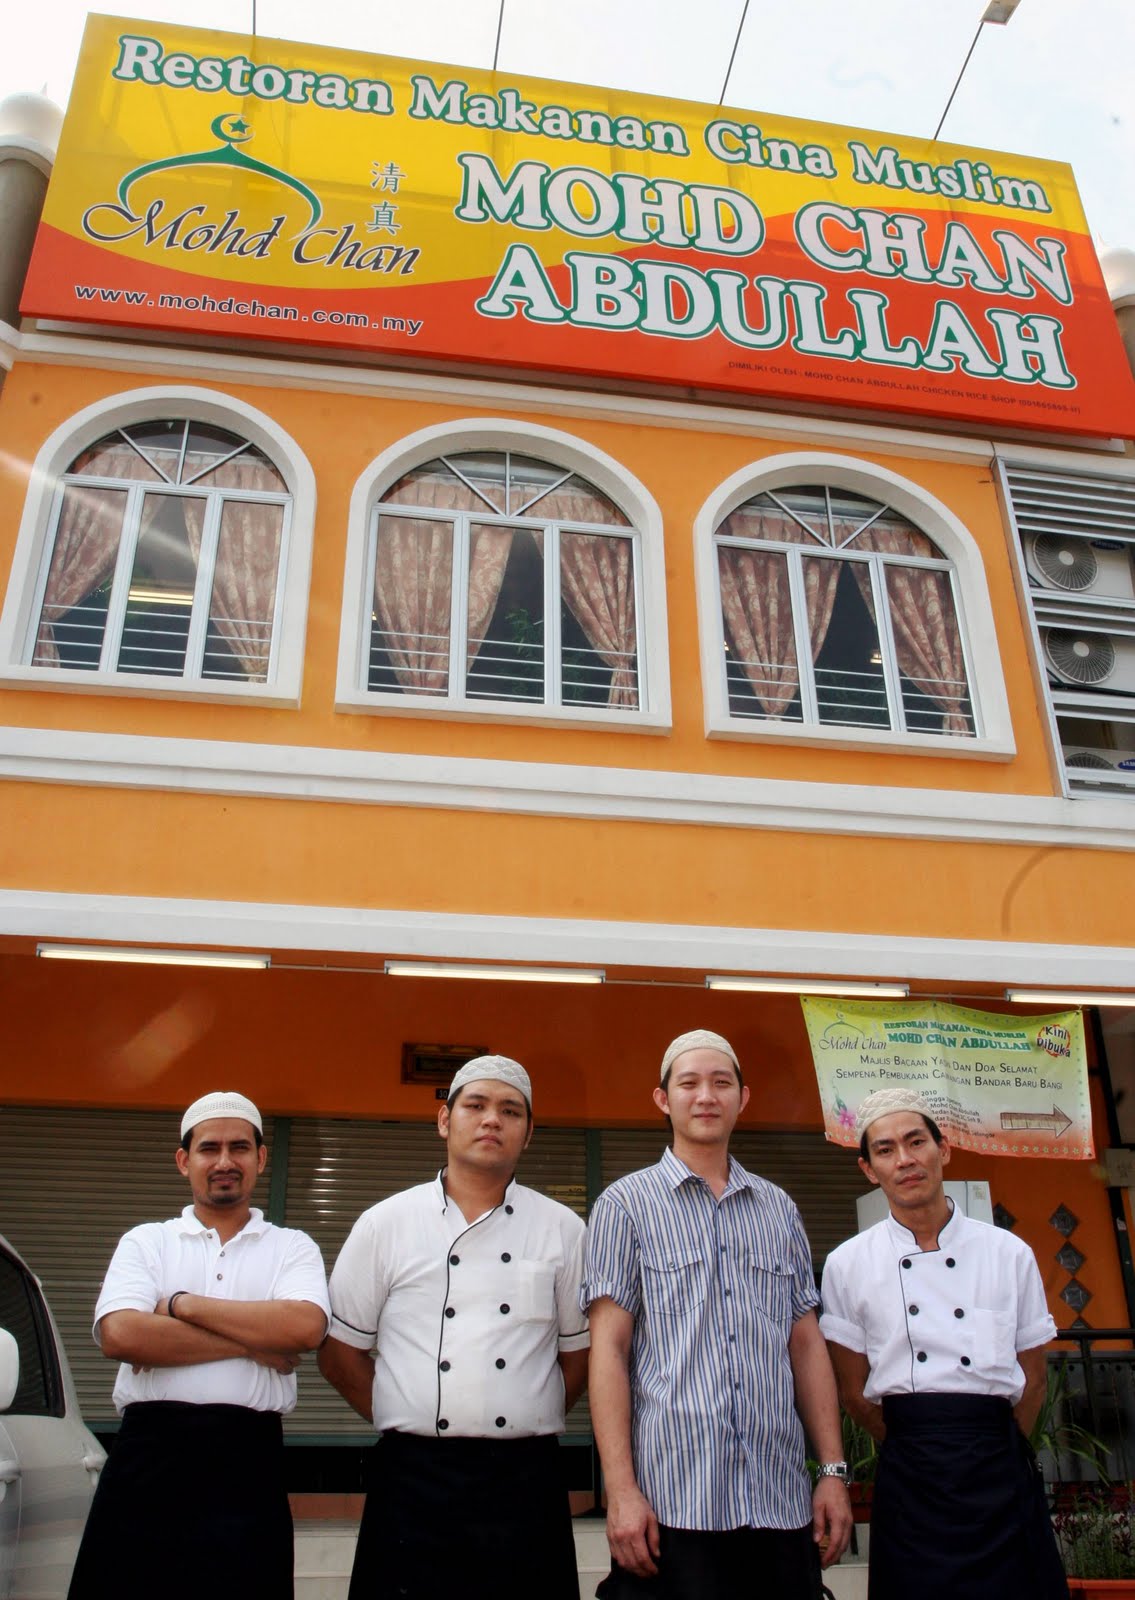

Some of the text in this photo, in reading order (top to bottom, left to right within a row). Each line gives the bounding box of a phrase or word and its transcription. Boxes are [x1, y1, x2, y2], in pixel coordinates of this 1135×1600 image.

[112, 34, 1052, 214] Restoran Makanan Cina Muslim
[367, 162, 406, 235] 清真
[82, 200, 422, 276] Mohd Chan
[455, 152, 1073, 305] MOHD CHAN
[75, 284, 424, 336] www.mohdchan.com.my
[474, 243, 1078, 390] ABDULLAH
[729, 361, 768, 372] DIMILIKI
[804, 370, 834, 381] MOHD
[836, 374, 864, 385] CHAN
[866, 378, 920, 392] ABDULLAH
[922, 385, 965, 398] CHICKEN
[966, 391, 989, 401] RICE
[990, 394, 1017, 404] SHOP
[819, 1036, 887, 1050] Mohd Chan
[883, 1020, 929, 1030] RESTORAN
[993, 1031, 1027, 1039] MUSLIM
[888, 1032, 1032, 1051] MOHD CHAN ABDULLAH
[1036, 1037, 1071, 1058] Dibuka
[1045, 1026, 1068, 1040] Kini
[921, 1089, 938, 1097] 2010
